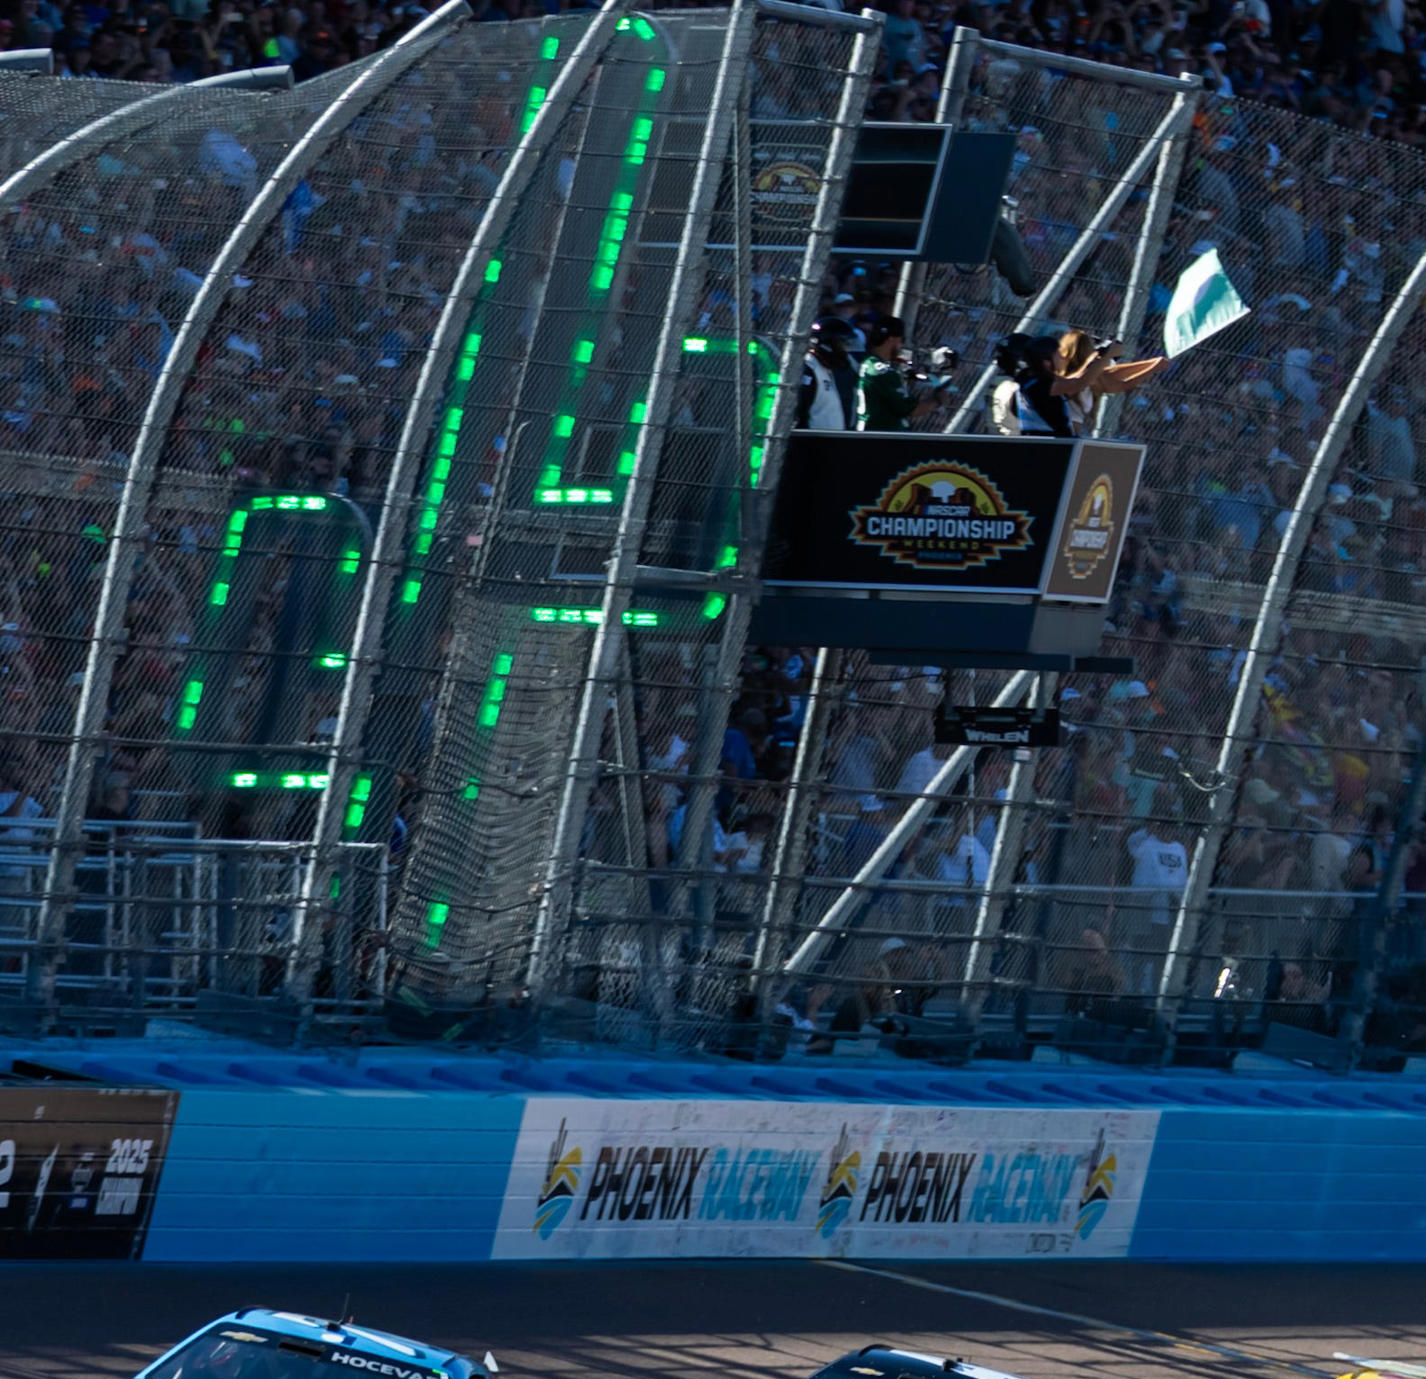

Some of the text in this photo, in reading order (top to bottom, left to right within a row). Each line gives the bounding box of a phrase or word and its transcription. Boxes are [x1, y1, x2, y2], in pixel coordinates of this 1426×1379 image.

[867, 516, 1015, 540] CHAMPIONSHIP
[903, 540, 981, 550] WEEKEND
[105, 1138, 154, 1174] 2025
[579, 1147, 823, 1221] PHOENIX RACEWAY
[859, 1151, 1082, 1223] PHOENIX RACEWAY
